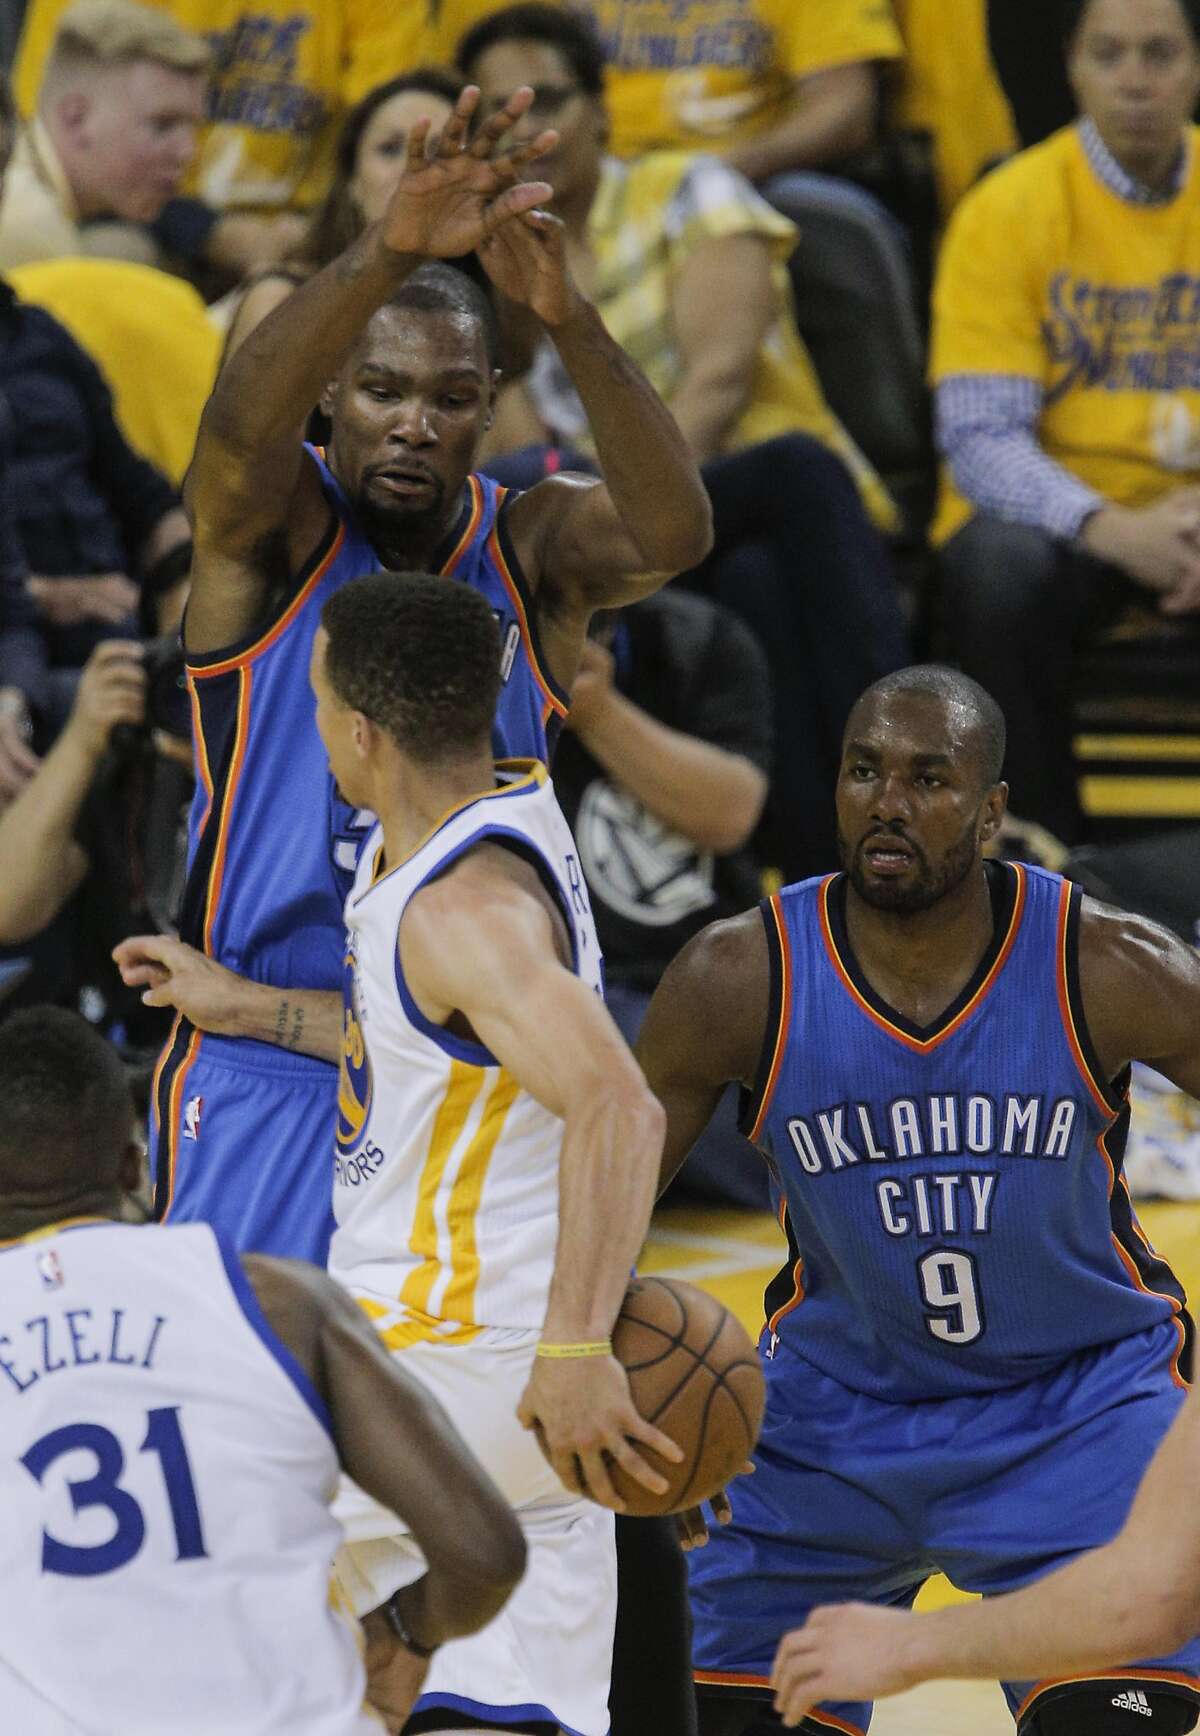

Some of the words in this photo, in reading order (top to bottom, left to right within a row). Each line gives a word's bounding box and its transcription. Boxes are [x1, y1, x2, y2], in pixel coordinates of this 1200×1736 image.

[786, 1095, 1077, 1175] OKLAHOMA
[877, 1174, 995, 1235] CITY
[919, 1250, 983, 1345] 9
[0, 1309, 166, 1393] EZELI
[19, 1406, 210, 1578] 31
[1111, 1698, 1153, 1717] adidas
